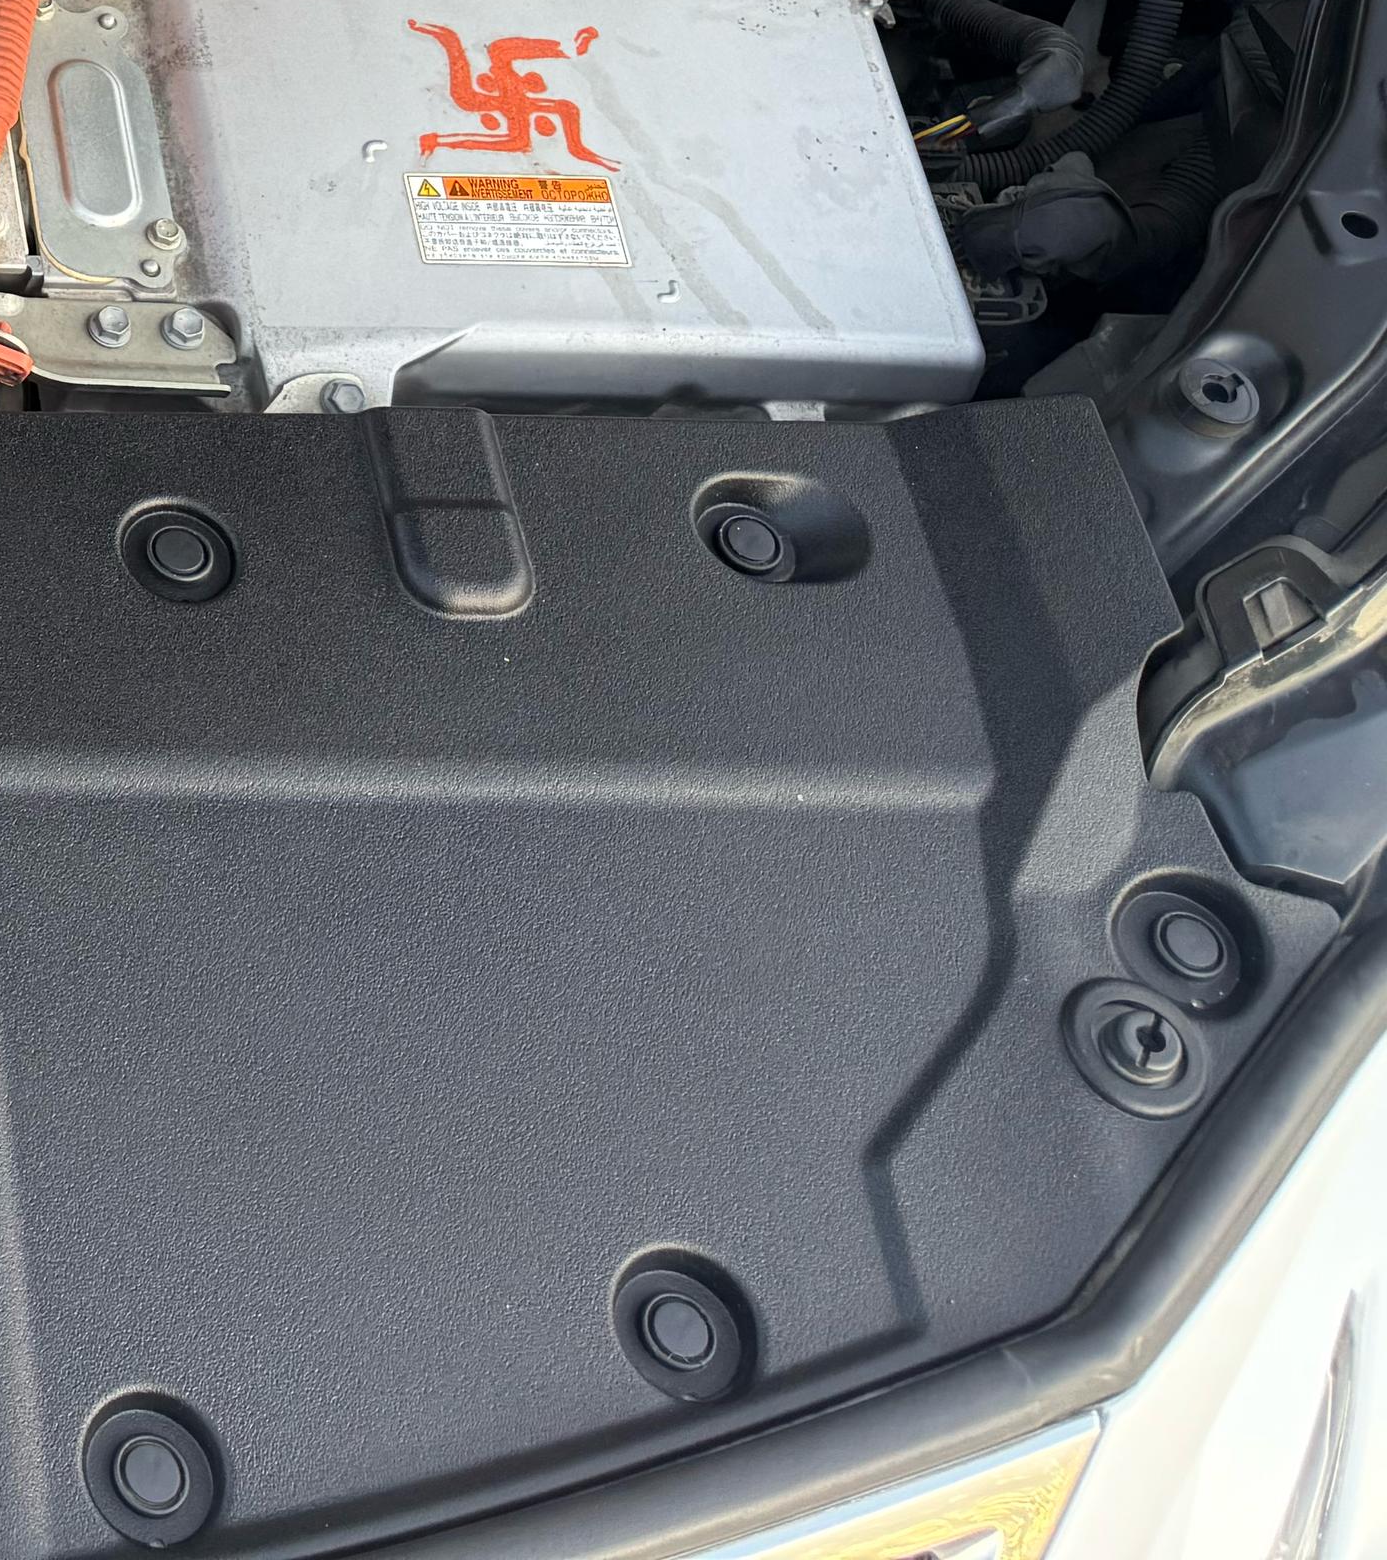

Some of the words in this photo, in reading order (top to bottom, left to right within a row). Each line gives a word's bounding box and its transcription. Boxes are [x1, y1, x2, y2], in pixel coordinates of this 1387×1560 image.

[468, 178, 519, 190] WARNING
[471, 188, 533, 199] AVERTISSEMENT
[541, 189, 609, 201] ОСТОРОЖНО
